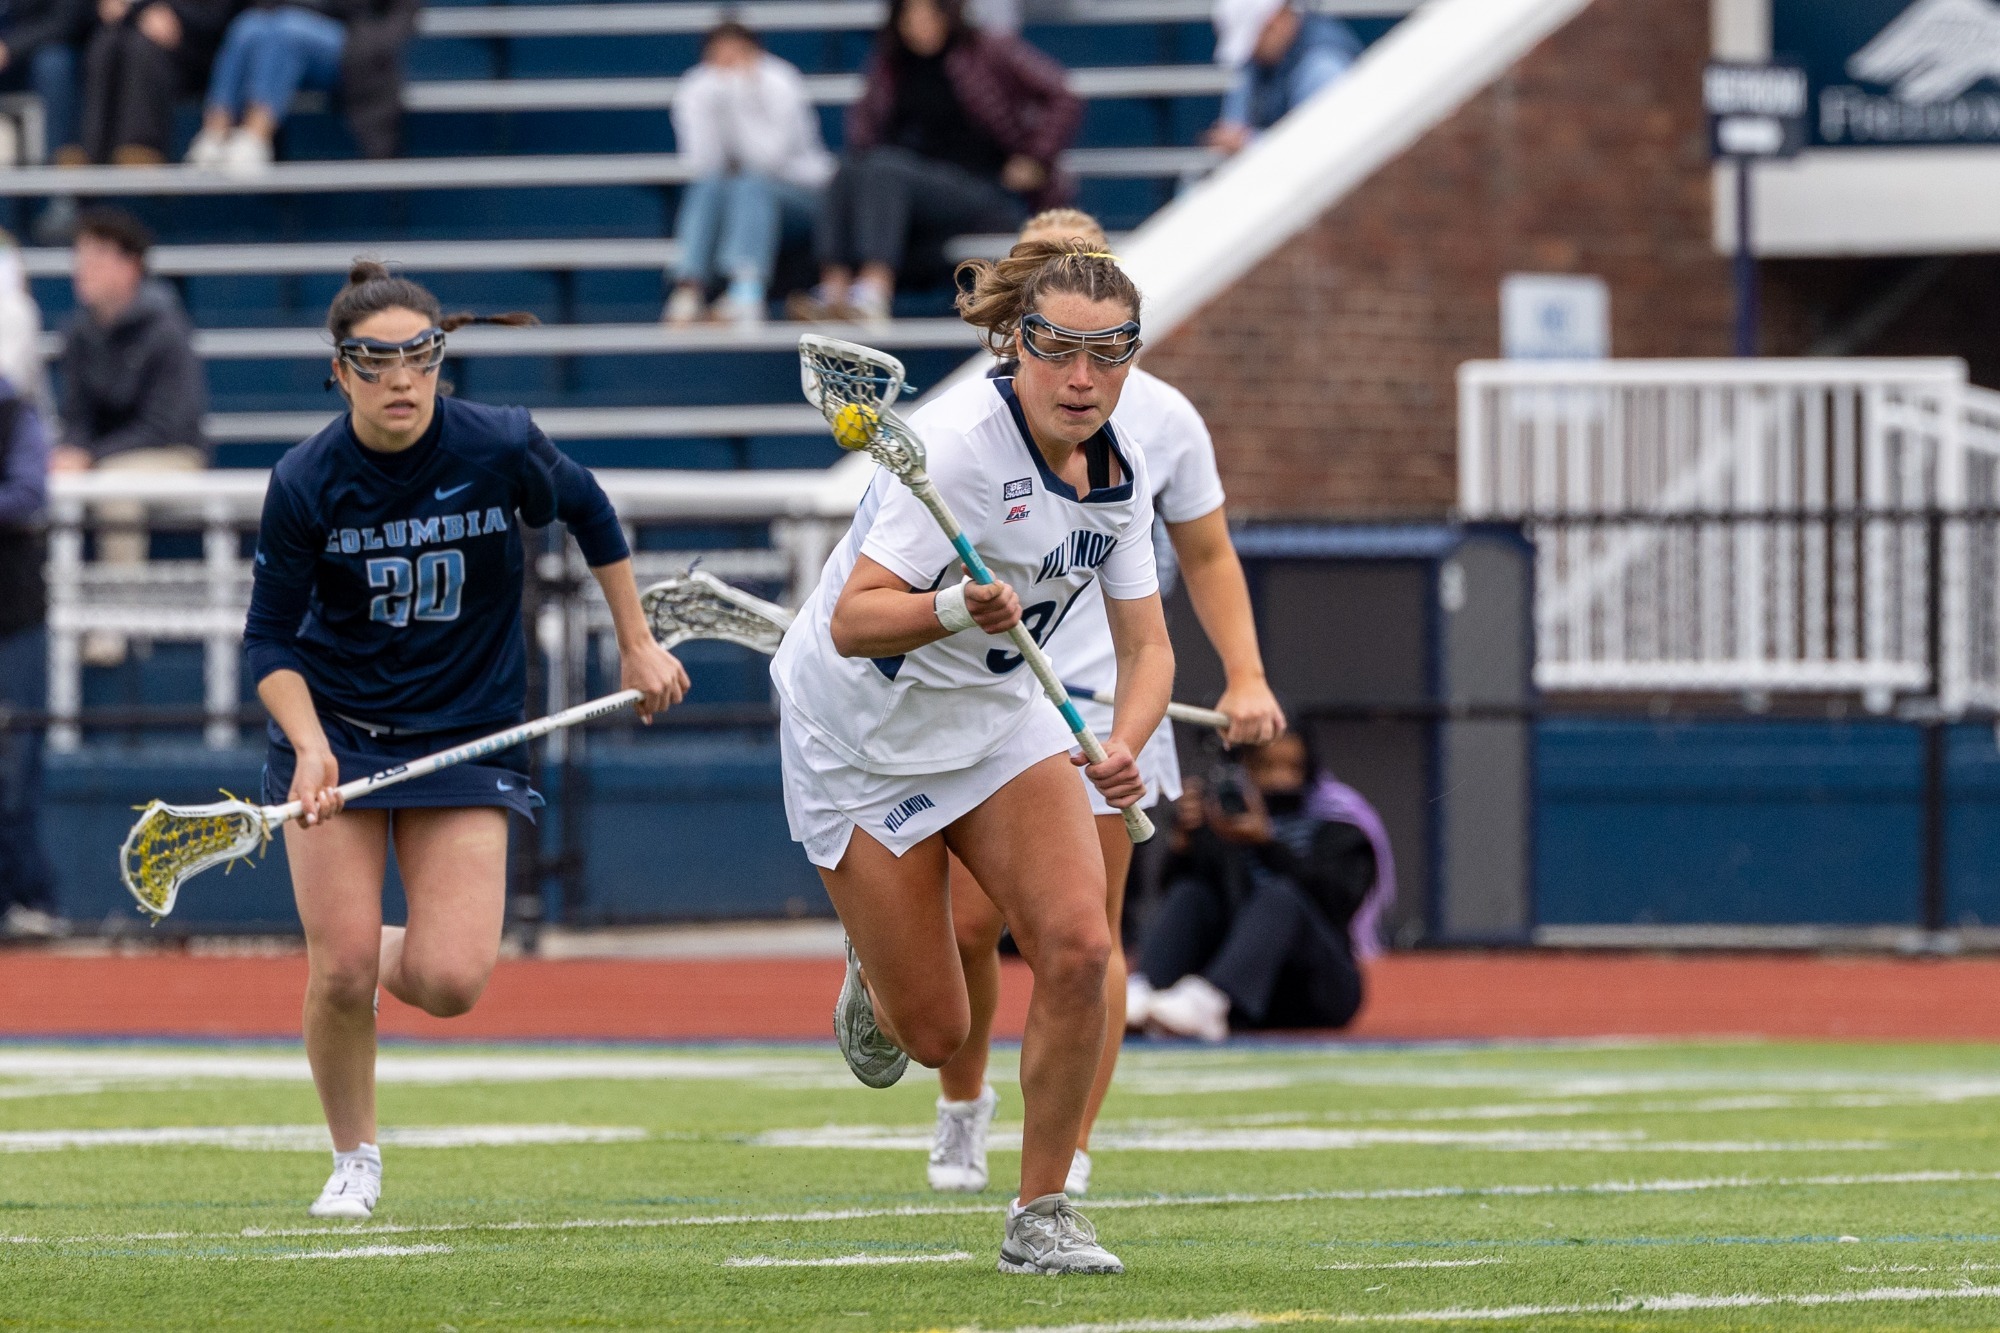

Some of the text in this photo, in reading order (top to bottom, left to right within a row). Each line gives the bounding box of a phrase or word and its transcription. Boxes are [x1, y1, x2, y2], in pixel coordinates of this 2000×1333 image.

[1006, 510, 1030, 520] EAST
[1011, 505, 1026, 514] BIG
[366, 549, 465, 627] 20
[883, 793, 936, 834] VILLANOVA
